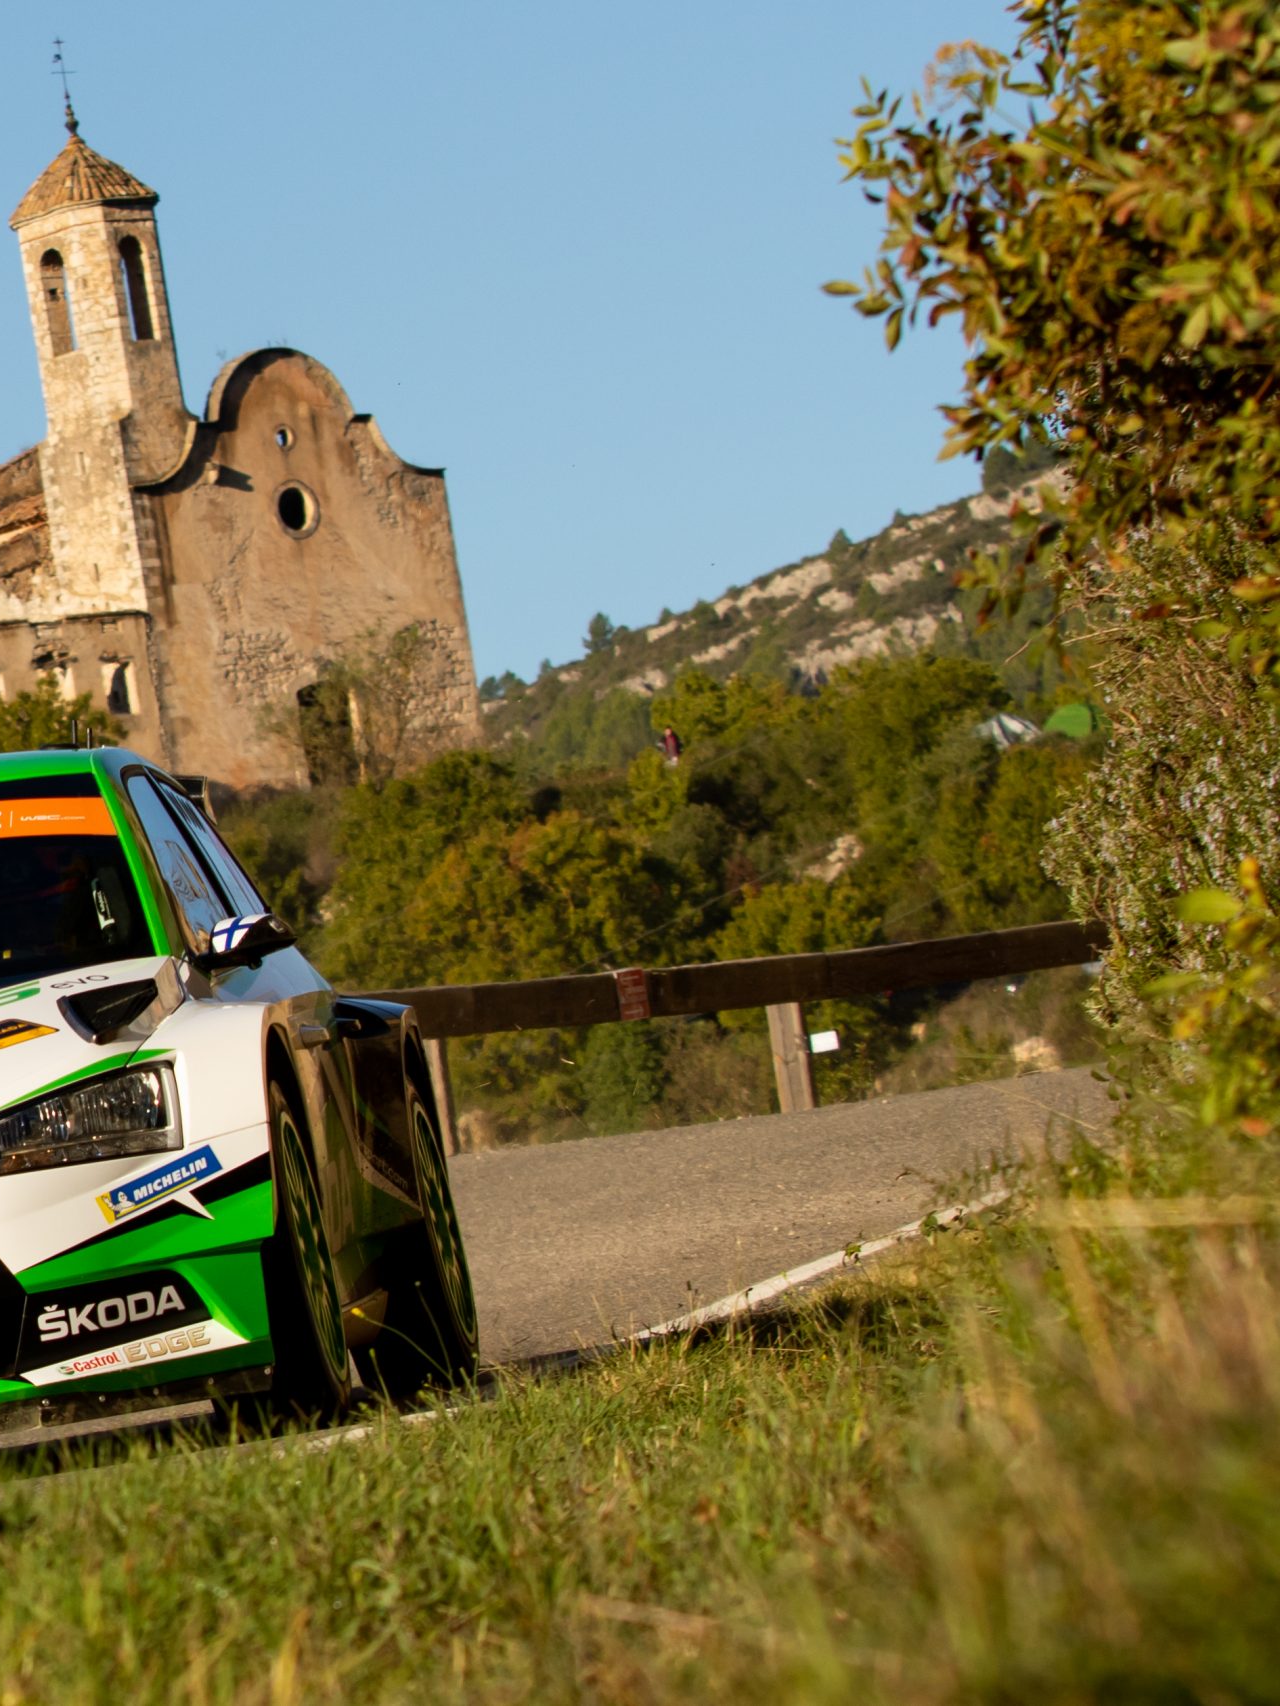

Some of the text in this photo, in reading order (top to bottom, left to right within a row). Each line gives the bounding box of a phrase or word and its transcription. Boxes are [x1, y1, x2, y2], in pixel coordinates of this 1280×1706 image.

[50, 974, 110, 990] evo
[133, 1156, 208, 1201] MICHELIN
[37, 1284, 186, 1342] ŠKODA
[73, 1325, 212, 1373] Castrol EDGE
